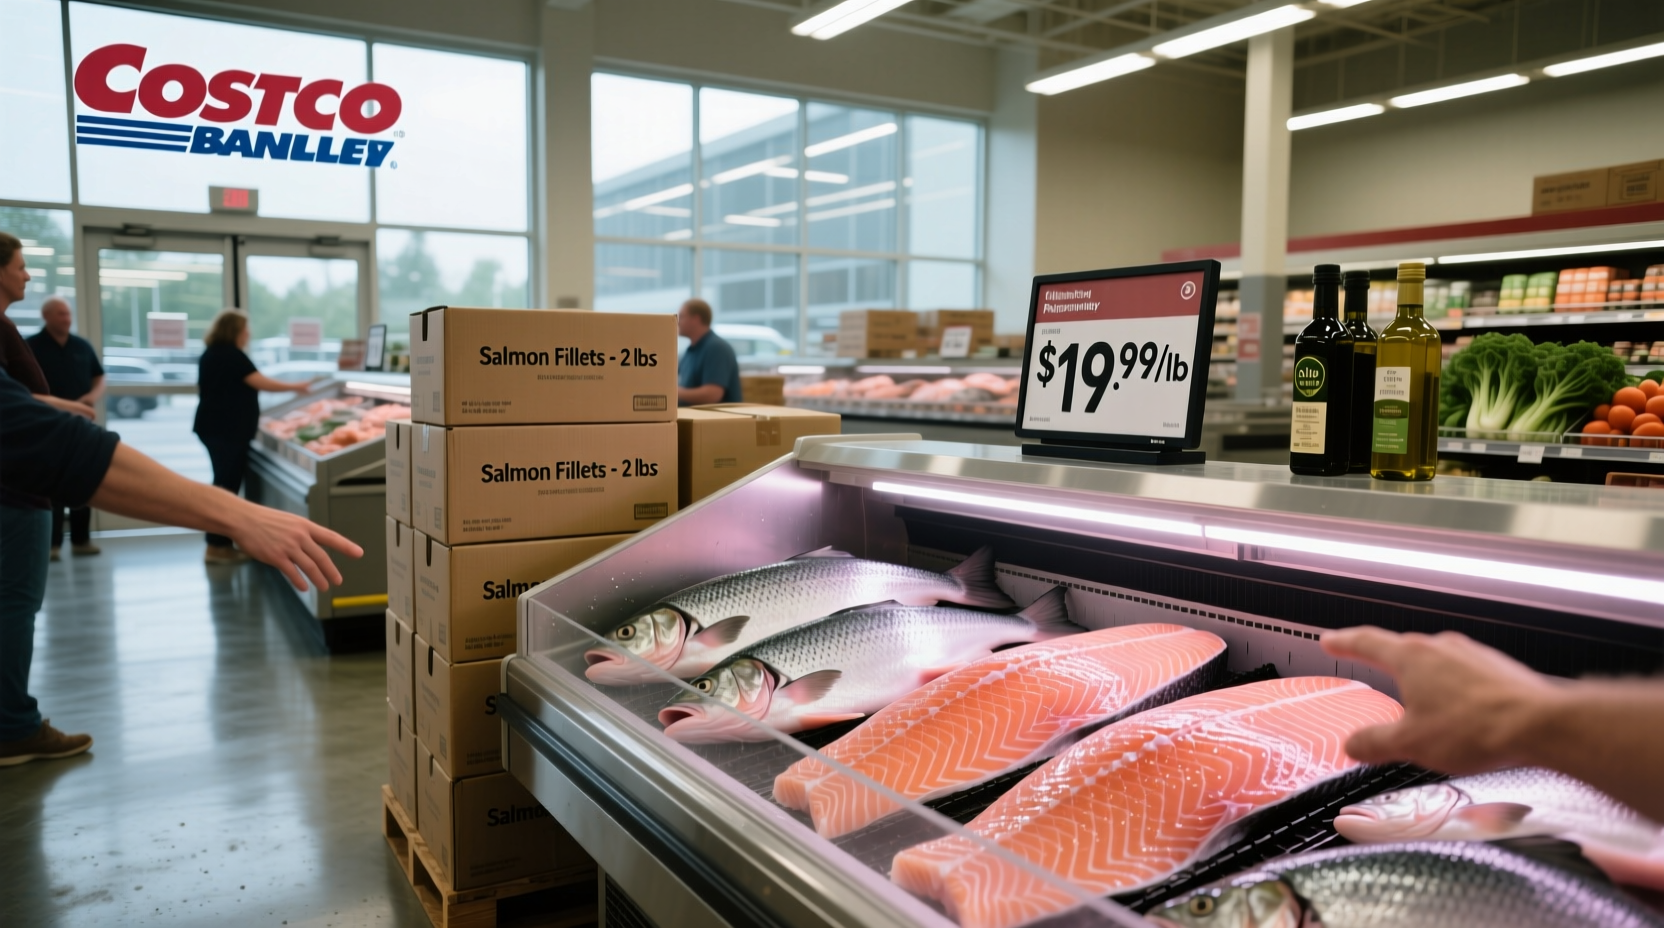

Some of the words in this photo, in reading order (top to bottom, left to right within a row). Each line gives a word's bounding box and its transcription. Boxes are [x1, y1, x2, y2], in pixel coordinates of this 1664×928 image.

[74, 43, 402, 134] COSTCO
[480, 346, 549, 366] Salmon
[555, 347, 605, 366] Fillets
[620, 348, 631, 366] 2
[634, 348, 658, 367] lbs
[1036, 340, 1188, 413] $19.99/lb
[481, 463, 550, 483] Salmon
[556, 461, 606, 480] Fillets
[622, 459, 632, 477] 2
[635, 458, 658, 477] lbs
[483, 579, 549, 600] Salm
[487, 804, 548, 827] Salmo
